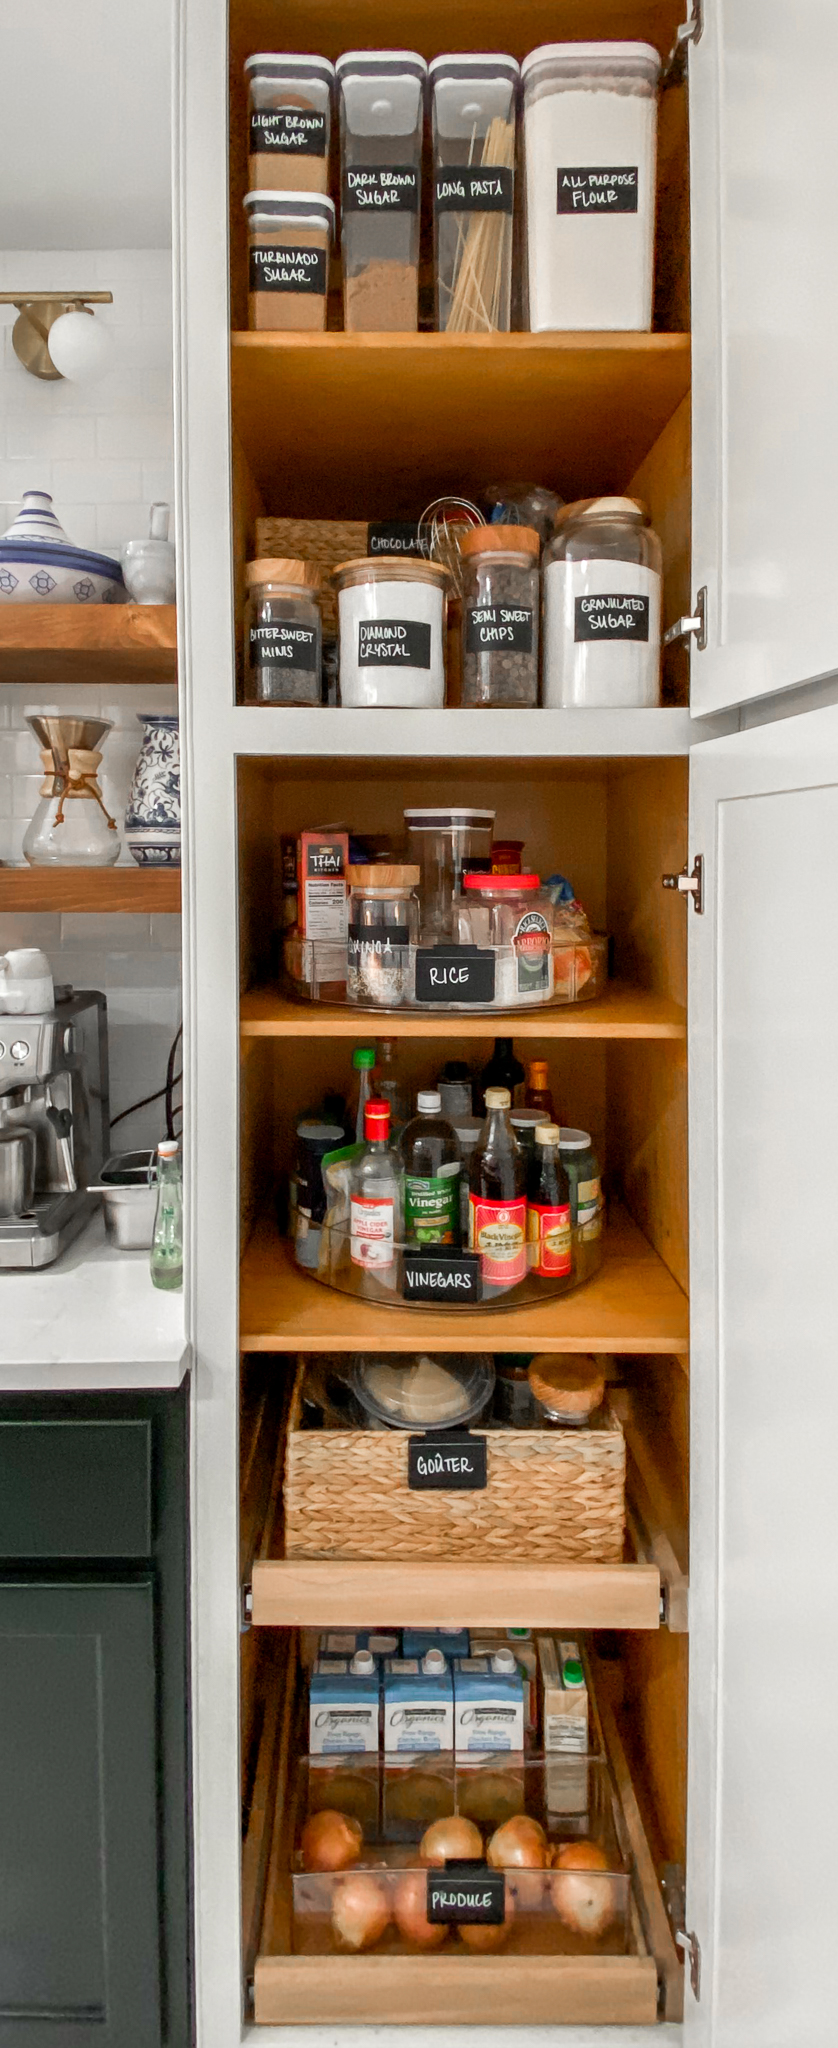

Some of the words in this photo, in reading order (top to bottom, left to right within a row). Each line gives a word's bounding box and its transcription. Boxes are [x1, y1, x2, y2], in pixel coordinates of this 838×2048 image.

[252, 116, 284, 129] LIGHT
[285, 115, 324, 129] BROWN
[264, 130, 308, 146] SUGAR
[347, 173, 377, 188] DARK
[380, 173, 416, 187] BROWN
[561, 175, 586, 188] ALL
[588, 172, 636, 187] PURPOSE
[436, 181, 466, 199] LONG
[470, 179, 504, 197] PASTA
[356, 189, 401, 206] SUGAR
[572, 189, 619, 207] FLOUR
[252, 250, 319, 266] TURBINADO
[264, 266, 311, 283] SUGAR
[581, 597, 645, 613] GRANULATED
[472, 610, 497, 625] SEMI
[500, 610, 532, 624] SWEET
[588, 613, 637, 630] SUGAR
[360, 626, 407, 642] DIAMOND
[479, 625, 514, 642] CHIPS
[261, 644, 293, 658] MINIS
[360, 642, 411, 658] CRYSTAL
[309, 855, 341, 867] THAI
[429, 966, 470, 986] RICE
[406, 1270, 472, 1289] VINEGARS
[417, 1453, 474, 1475] GOÛTER
[432, 1892, 492, 1909] PRODUCE
